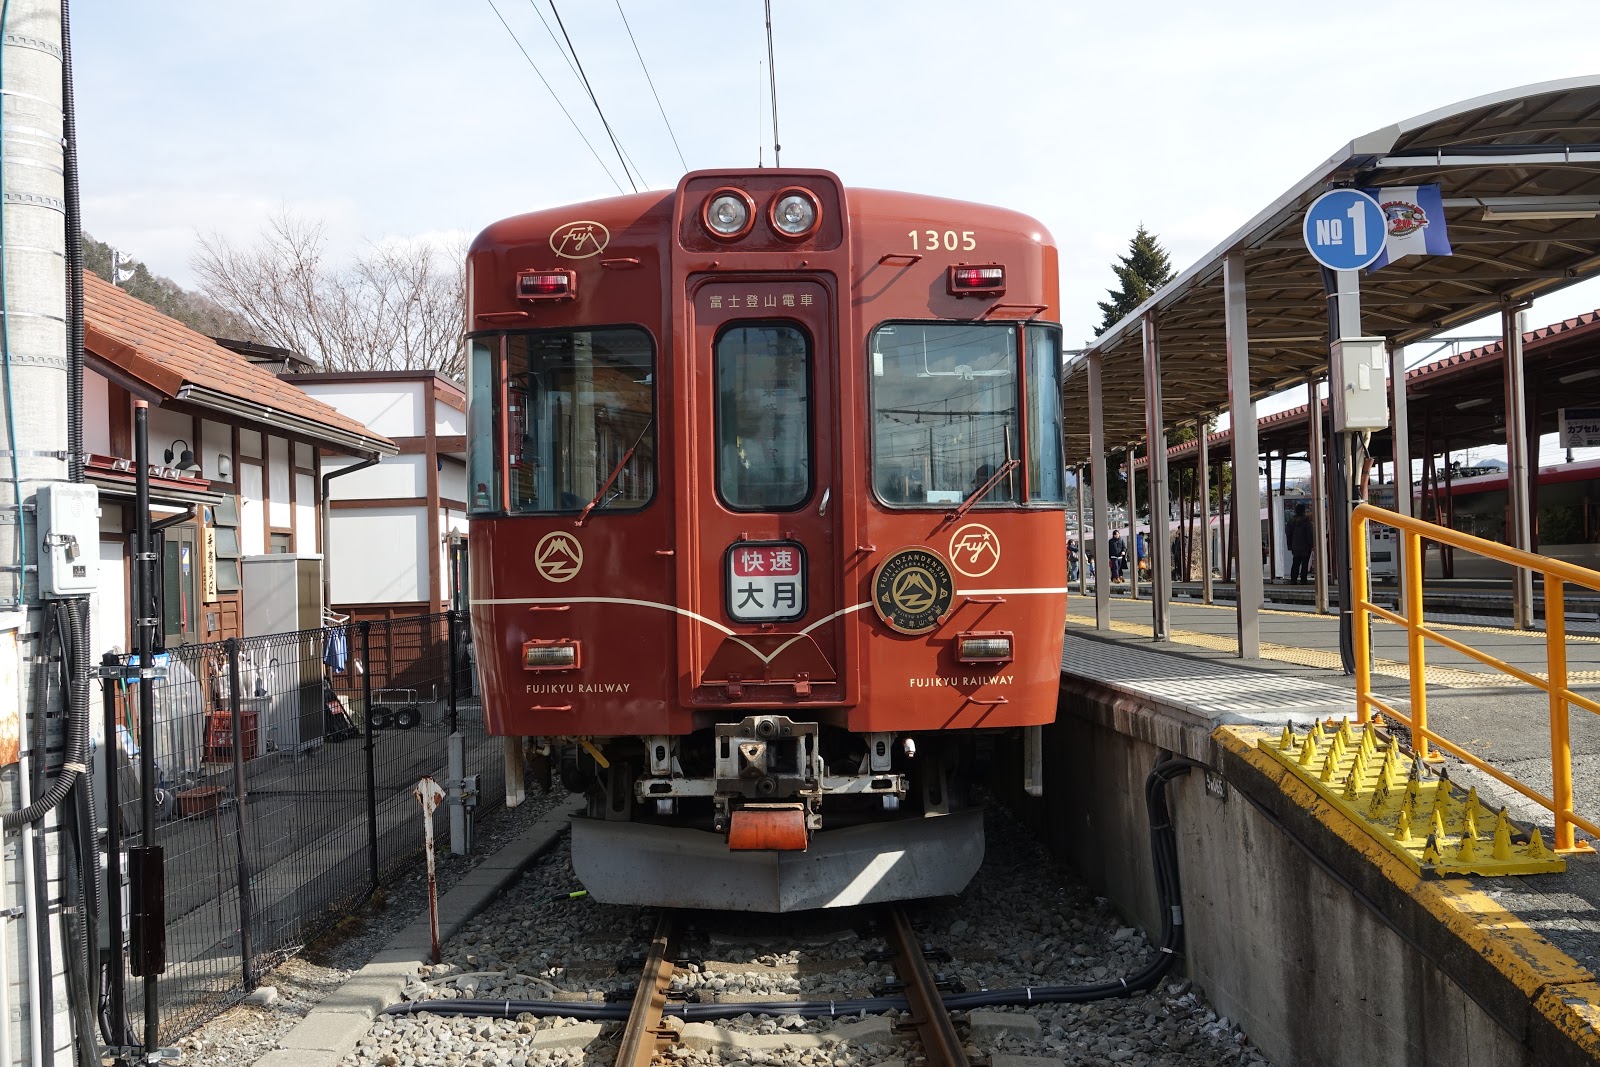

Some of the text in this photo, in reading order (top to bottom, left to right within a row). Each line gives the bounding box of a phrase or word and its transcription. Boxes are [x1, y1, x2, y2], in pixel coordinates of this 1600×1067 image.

[1347, 200, 1367, 255] 1
[908, 230, 977, 251] 1305
[709, 294, 814, 308] 富士登山電車
[741, 550, 793, 573] 快速
[737, 581, 799, 609] 大月
[525, 684, 631, 694] FUJIKYU RAILWAY
[909, 676, 1014, 688] FUJIKYU RAILWAY
